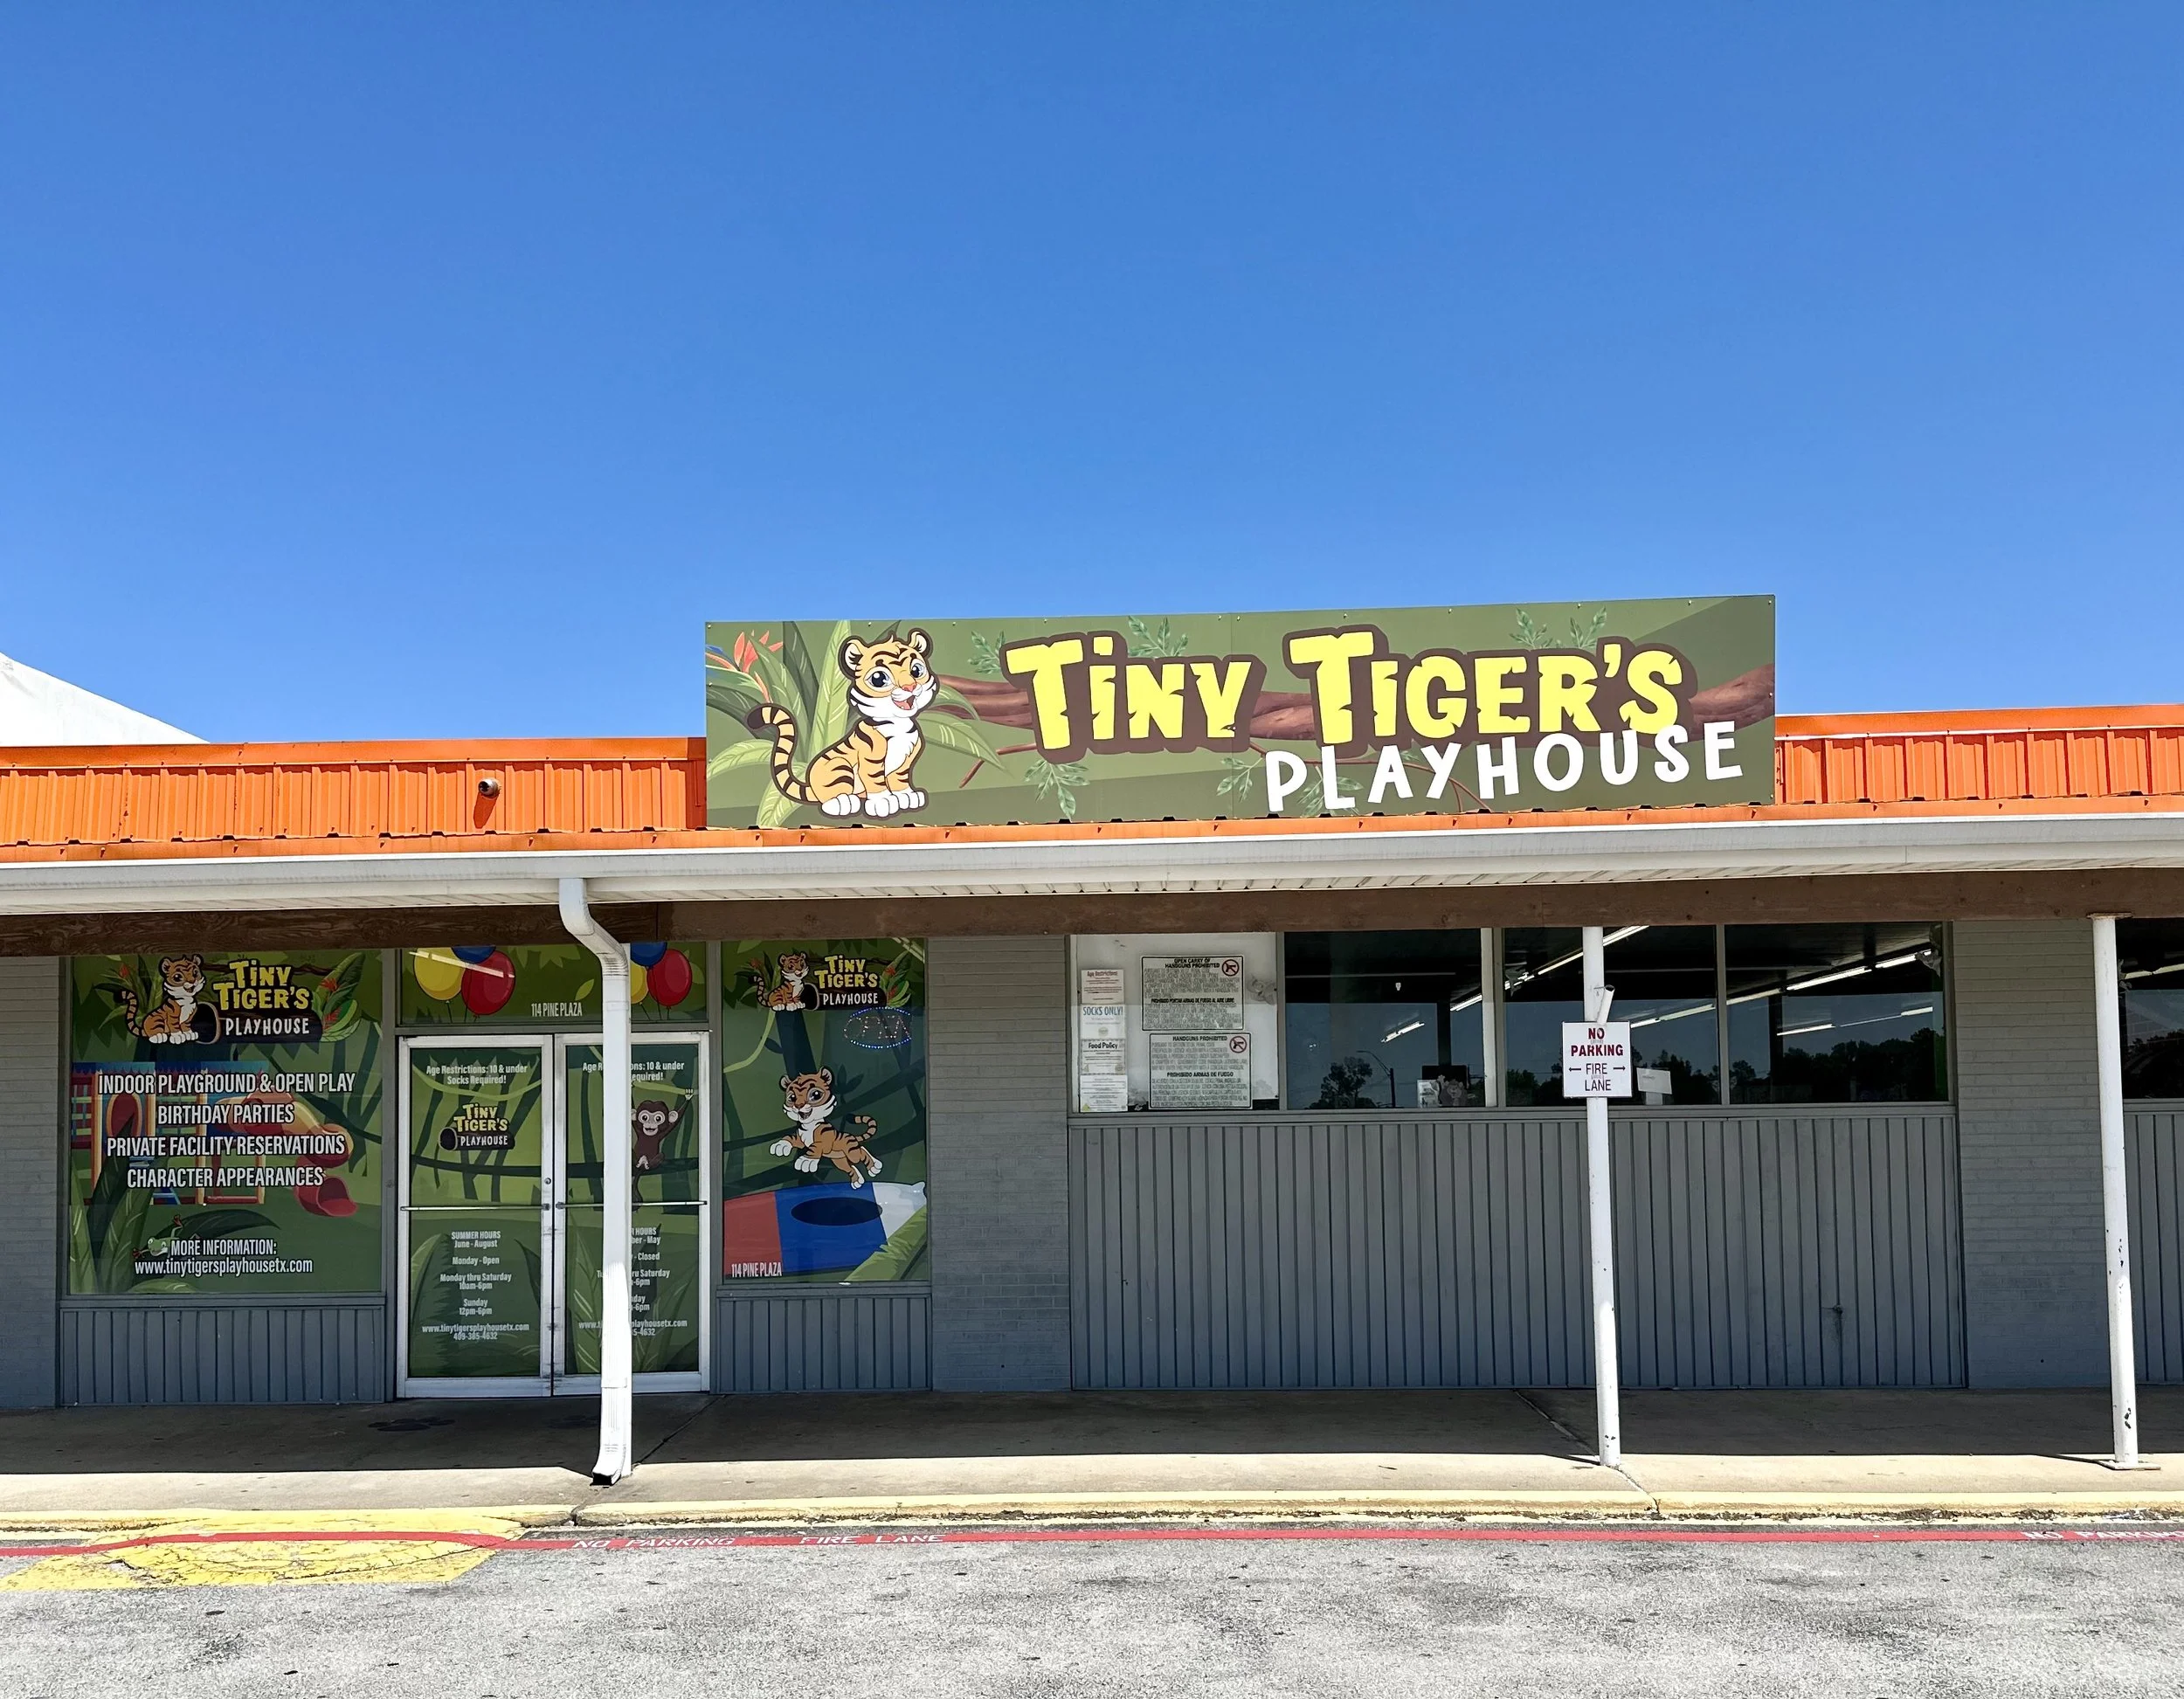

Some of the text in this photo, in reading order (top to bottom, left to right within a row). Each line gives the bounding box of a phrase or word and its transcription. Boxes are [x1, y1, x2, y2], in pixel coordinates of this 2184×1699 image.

[1265, 721, 1743, 813] PLAYHOUSE
[814, 970, 878, 989] TIGER'S
[212, 982, 310, 1011] TIGER'S
[823, 992, 879, 1005] PLAYHOUSE
[531, 1002, 583, 1017] 114 PINE PLAZA
[1083, 1006, 1123, 1016] SOCKS ONLY!
[225, 1017, 309, 1036] PLAYHOUSE
[1588, 1027, 1605, 1039] NO
[1571, 1044, 1623, 1056] PARKING
[426, 1064, 528, 1075] Age Restrictions: 10 & under
[583, 1062, 597, 1073] Age
[646, 1061, 653, 1070] 10
[655, 1061, 661, 1070] &
[662, 1060, 684, 1070] under
[1586, 1063, 1607, 1074] FIRE
[447, 1074, 506, 1086] Socks Required!
[631, 1071, 663, 1082] equired!
[99, 1073, 356, 1094] INDOOR PLAYGROUND & OPEN PLAY
[1585, 1080, 1611, 1091] LANE
[157, 1103, 294, 1124] BIRTHDAY PARTIES
[453, 1116, 508, 1132] TIGER'S
[107, 1136, 345, 1157] PRIVATE FACILITY RESERVATIONS
[460, 1136, 508, 1146] PLAYHOUSE
[127, 1167, 324, 1188] CHARACTER APPEARANCES
[473, 1240, 498, 1249] August
[646, 1236, 661, 1245] May
[170, 1239, 278, 1256] MORE INFORMATION:
[452, 1257, 479, 1266] Monday
[482, 1257, 500, 1266] Open
[637, 1252, 660, 1260] Closed
[135, 1258, 314, 1277] www.tinytigersplayhousetx.com
[731, 1261, 783, 1278] 114 PINE PLAZA
[439, 1274, 467, 1283] Monday
[481, 1273, 512, 1282] Saturday
[640, 1269, 670, 1279] Saturday
[459, 1282, 493, 1291] 10am-6pm
[463, 1298, 488, 1308] Sunday
[459, 1308, 493, 1316] 12pm-6pm
[422, 1323, 530, 1334] www.tinytigersplayhousetx.com
[572, 1533, 736, 1549] NO PARKING
[798, 1534, 945, 1544] FIRE LANE
